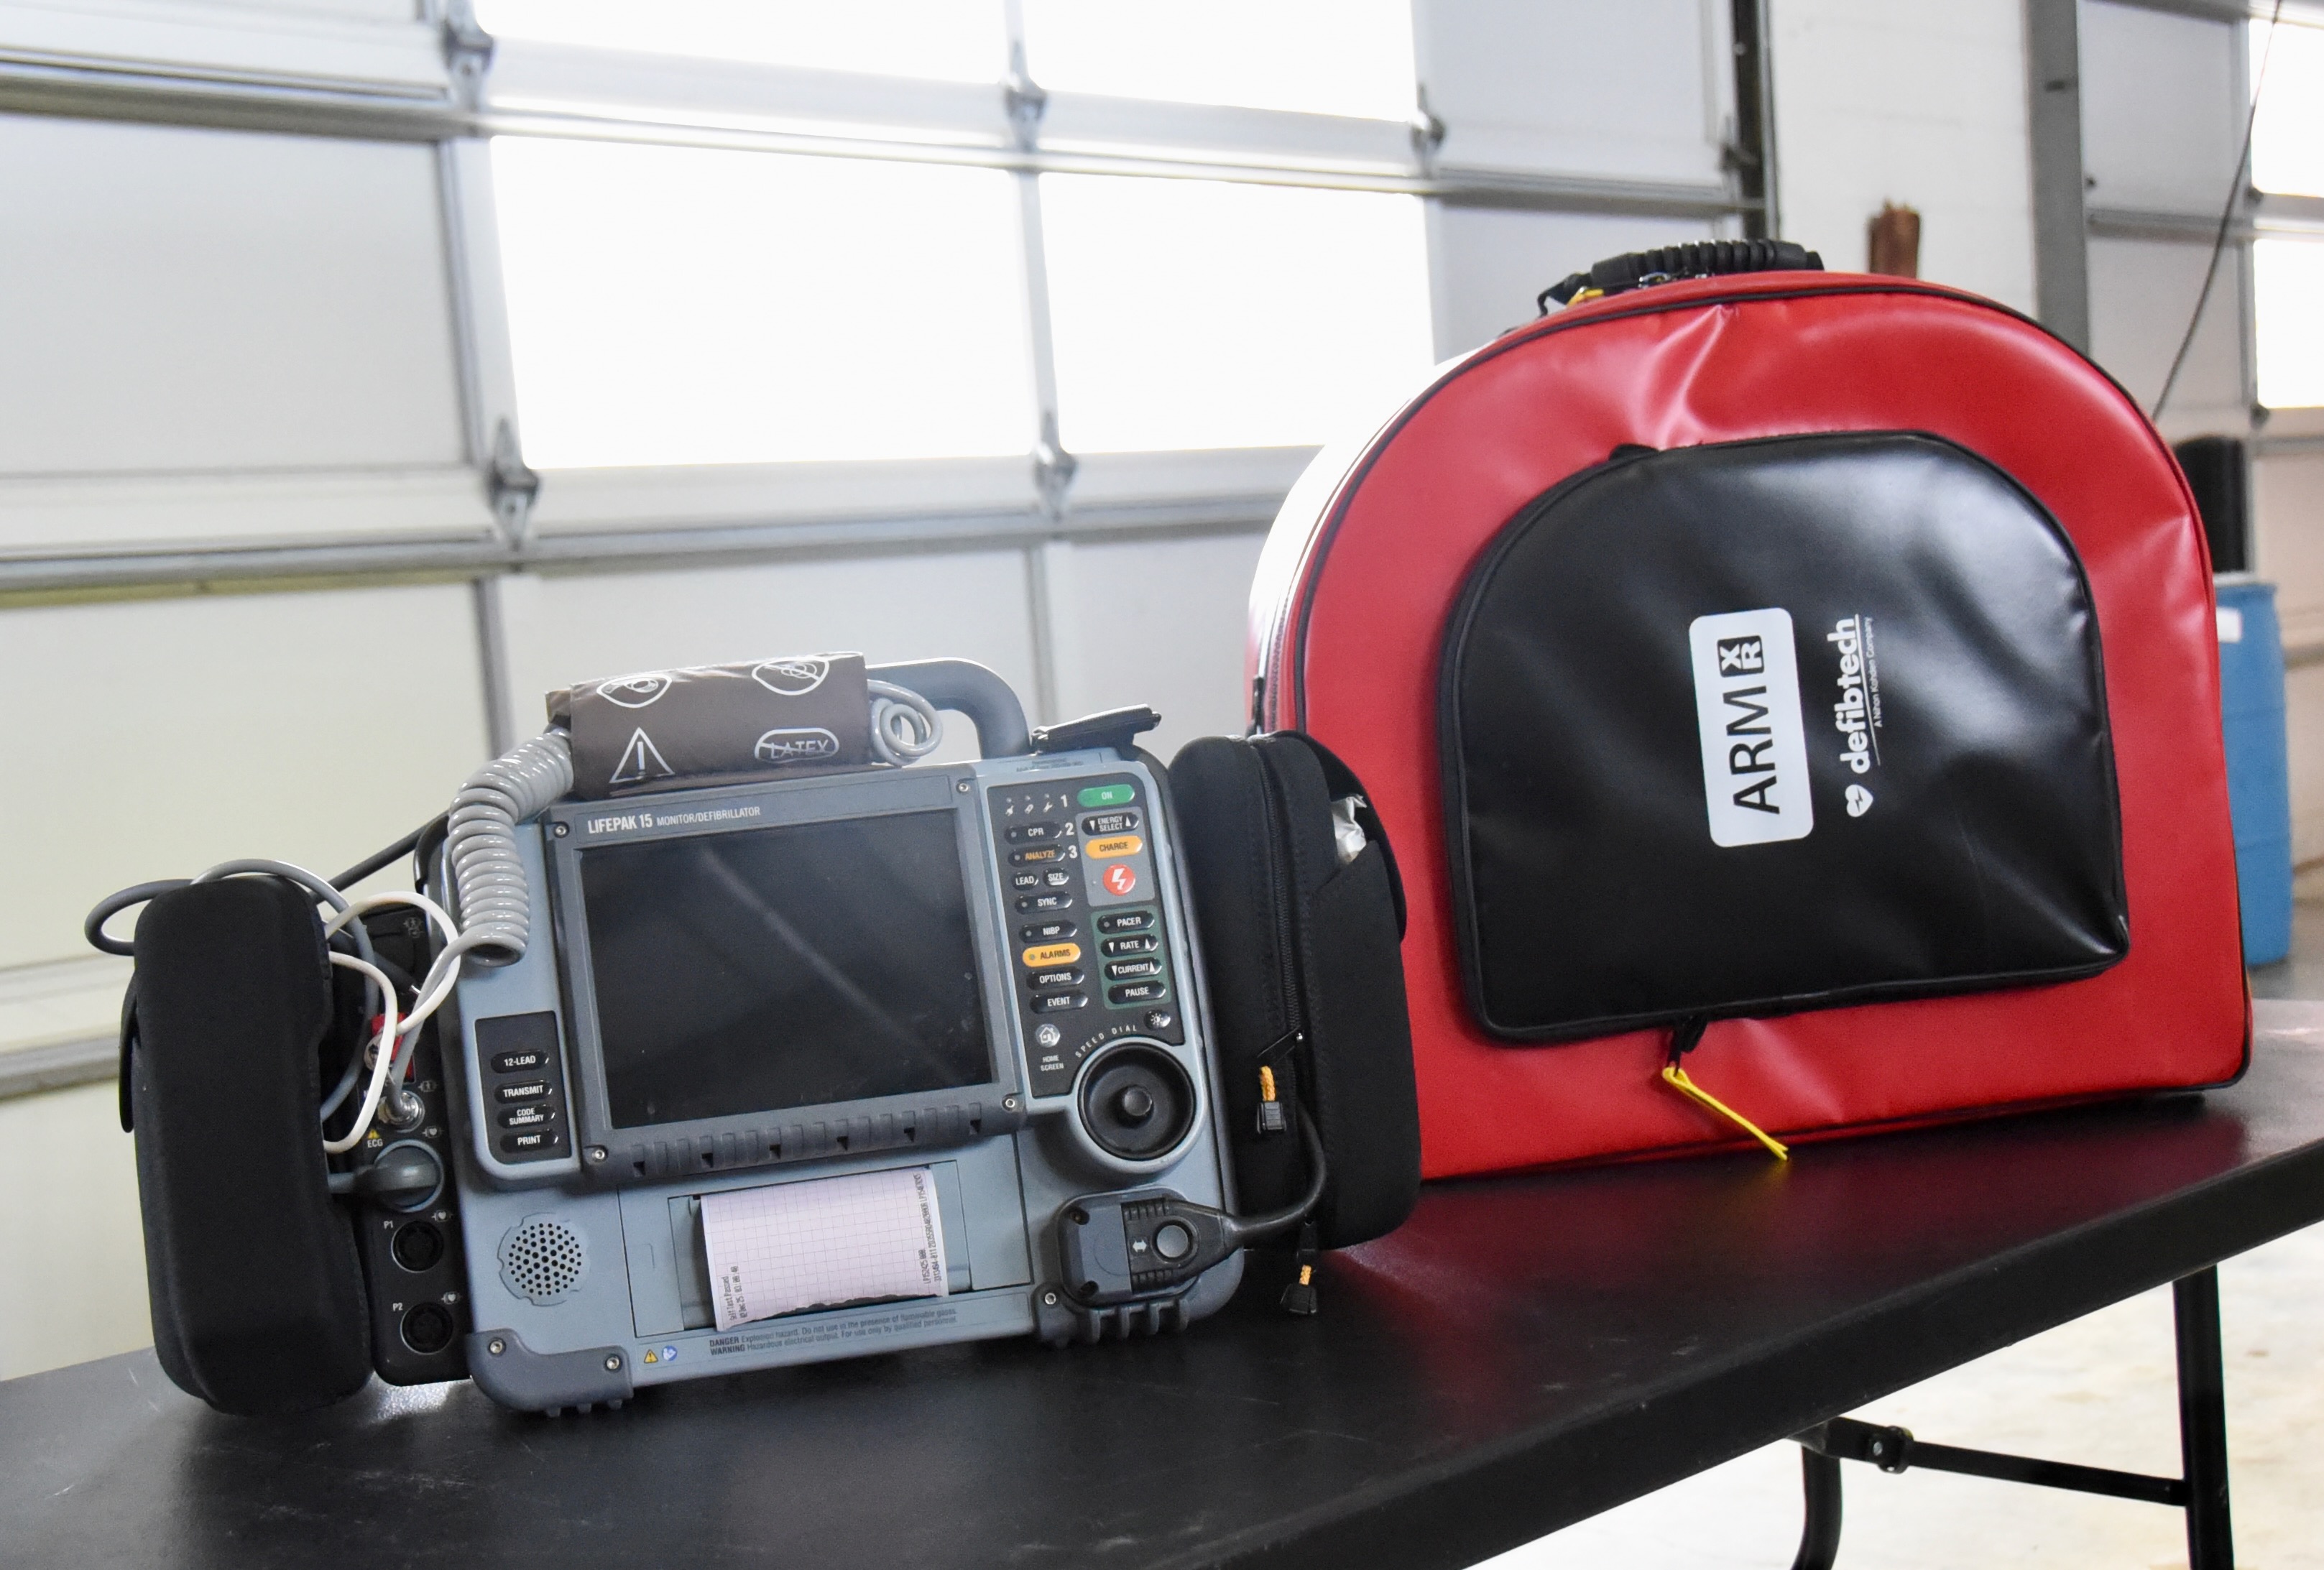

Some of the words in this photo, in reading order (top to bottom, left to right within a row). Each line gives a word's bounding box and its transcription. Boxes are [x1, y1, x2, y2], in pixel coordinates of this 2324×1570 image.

[1864, 617, 1875, 658] Company
[1827, 618, 1871, 774] defibtech
[1873, 693, 1881, 719] Nihon
[771, 739, 829, 759] LATEX
[1723, 685, 1780, 815] ARM
[1101, 791, 1113, 800] ON
[1060, 795, 1068, 808] 1
[588, 815, 637, 834] LIFEPAK
[639, 813, 653, 828] 15
[656, 806, 761, 826] MONITOR/DEFIBRILLATOR
[1097, 816, 1122, 825] ENERGY
[1028, 828, 1044, 836] CPR
[1064, 823, 1074, 835] 2
[1099, 823, 1123, 831] SELECT
[1099, 841, 1128, 851] CHARGE
[1025, 849, 1055, 861] ANALYZE
[1069, 846, 1078, 859] 3
[1015, 875, 1034, 885] LEAD
[1048, 872, 1064, 882] SIZE
[1037, 897, 1057, 906] SYNC
[1117, 916, 1141, 925] PACER
[1043, 925, 1060, 935] NIBP
[1120, 940, 1140, 950] RATE
[1040, 948, 1070, 959] ALARMS
[1117, 963, 1148, 974] CURRENT
[1039, 972, 1071, 983] OPTIONS
[1125, 987, 1150, 997] PAUSE
[1047, 996, 1071, 1007] EVENT
[1075, 1033, 1105, 1058] SPEED
[1112, 1025, 1138, 1035] DIAL
[504, 1055, 536, 1066] 12-LEAD
[1040, 1062, 1064, 1071] SCREEN
[503, 1085, 544, 1097] TRANSMIT
[517, 1107, 535, 1116] CODE
[509, 1114, 544, 1125] SUMMARY
[367, 1139, 383, 1148] ECG
[517, 1135, 541, 1145] PRINT
[392, 1302, 402, 1311] P2
[709, 1336, 739, 1347] DANGER
[860, 1316, 890, 1327] presence
[710, 1344, 745, 1355] WARNING
[747, 1340, 782, 1352] Hazardous
[784, 1335, 814, 1346] electrical
[868, 1326, 882, 1335] only
[894, 1320, 922, 1331] qualified
